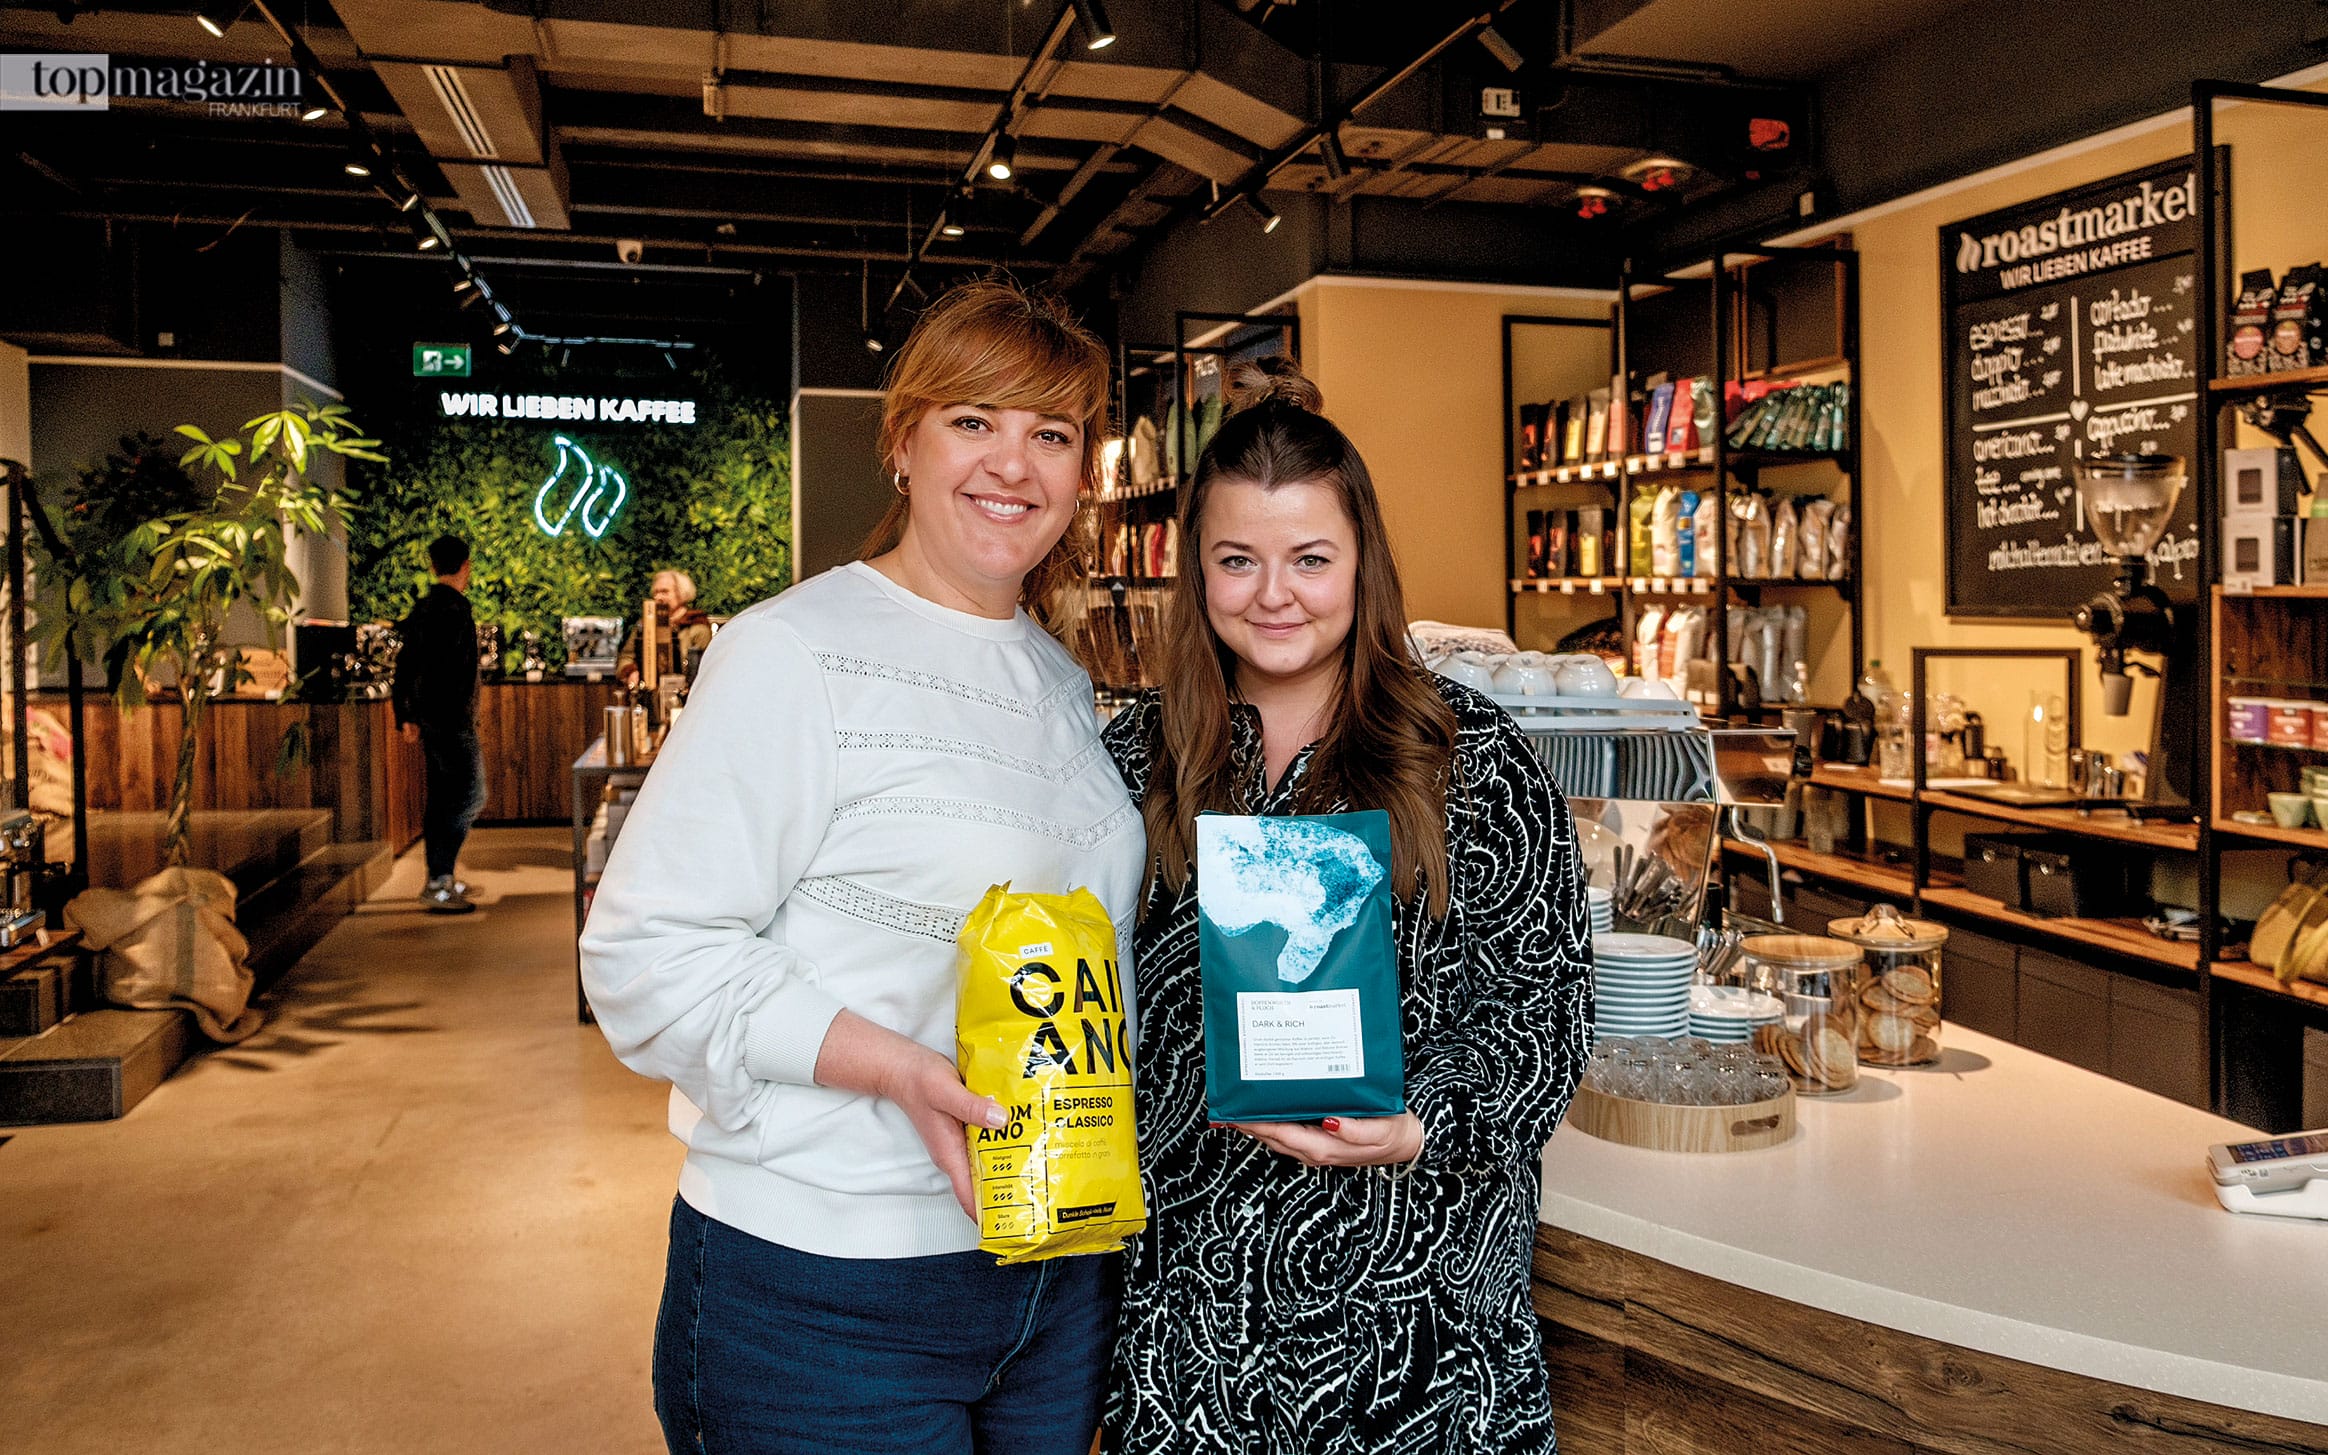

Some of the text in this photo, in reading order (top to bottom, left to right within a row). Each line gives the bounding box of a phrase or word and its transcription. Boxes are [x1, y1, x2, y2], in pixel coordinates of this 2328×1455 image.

[1981, 173, 2197, 269] roastmarket
[2000, 236, 2153, 290] WIR LIEBEN KAFFEE
[440, 392, 696, 424] WIR LIEBEN KAFFEE
[1010, 958, 1125, 1018] CAI
[1252, 1020, 1305, 1028] DARK & RICH
[1053, 1096, 1113, 1111] ESPRESSO
[1054, 1115, 1114, 1129] CLASSICO
